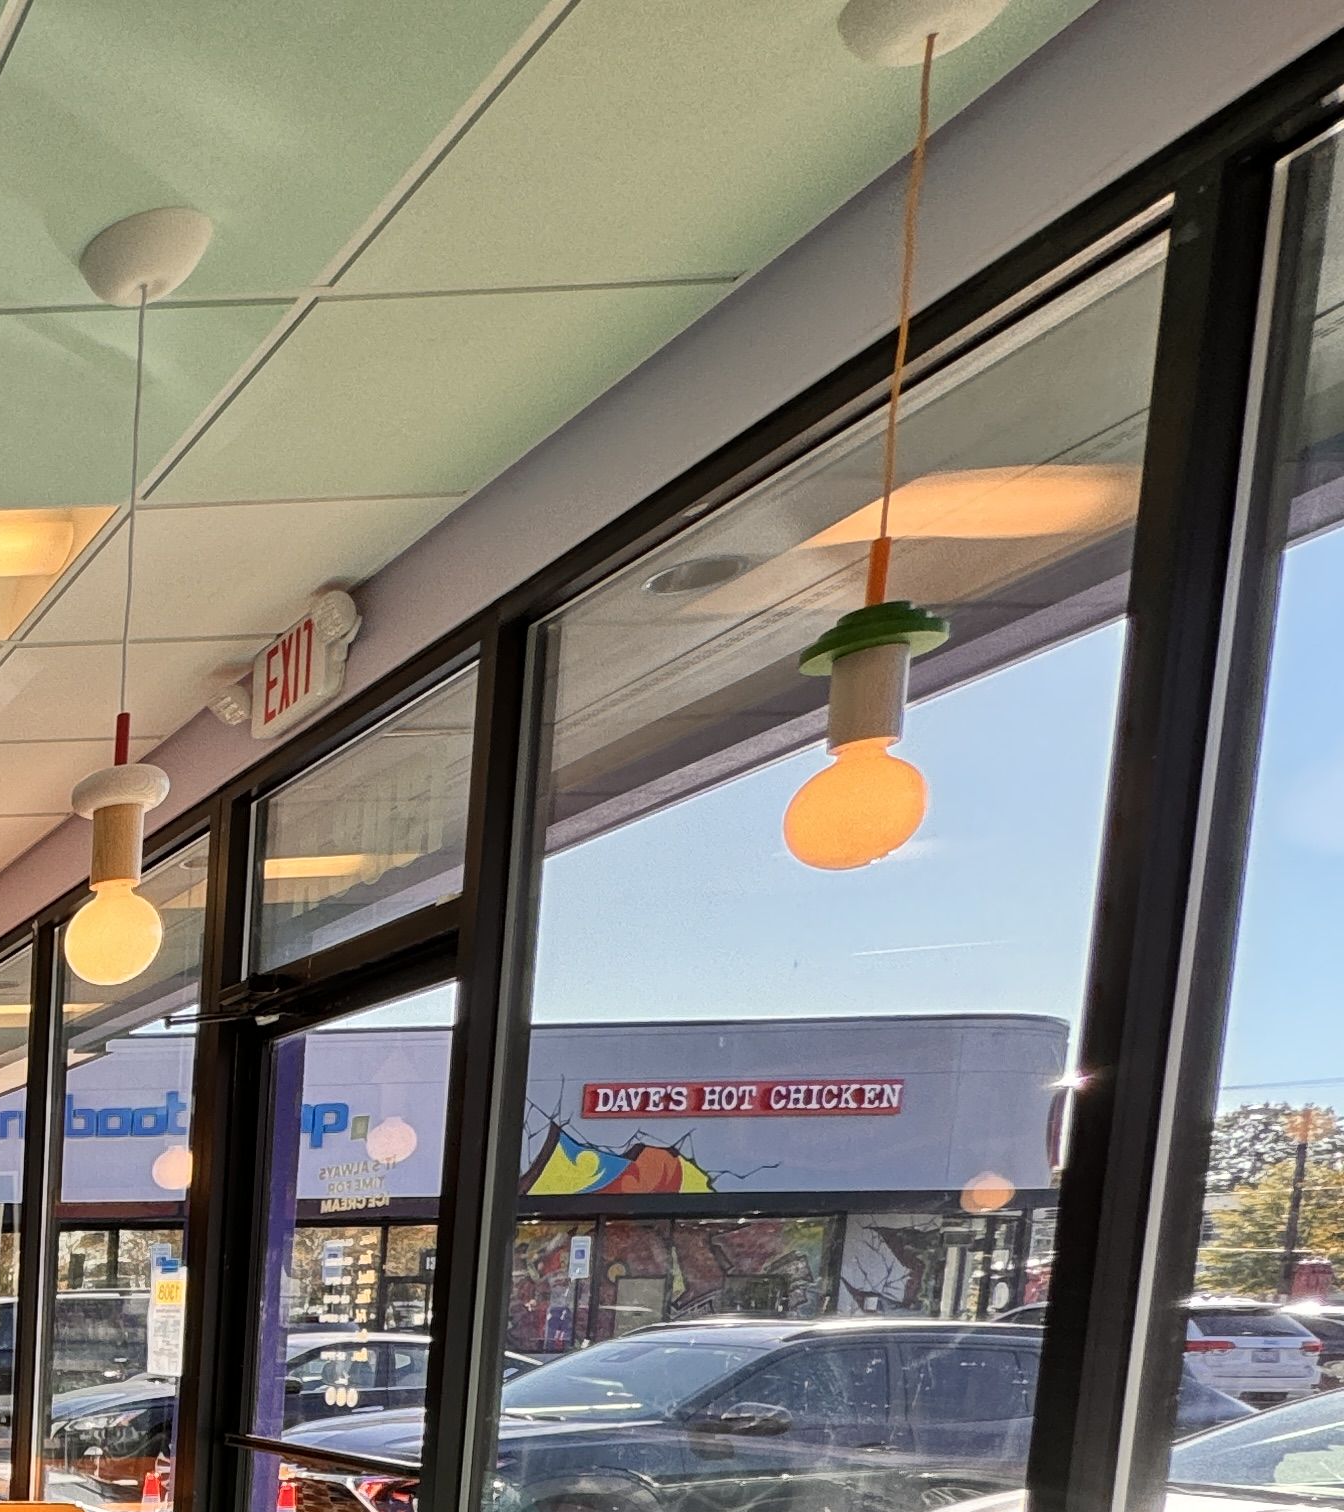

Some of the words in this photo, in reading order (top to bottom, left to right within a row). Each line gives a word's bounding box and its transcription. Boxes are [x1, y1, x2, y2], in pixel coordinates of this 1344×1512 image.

[263, 618, 313, 725] EXIT
[594, 1087, 688, 1113] DAVE'S
[701, 1085, 757, 1110] HOT
[769, 1084, 904, 1110] CHICKEN
